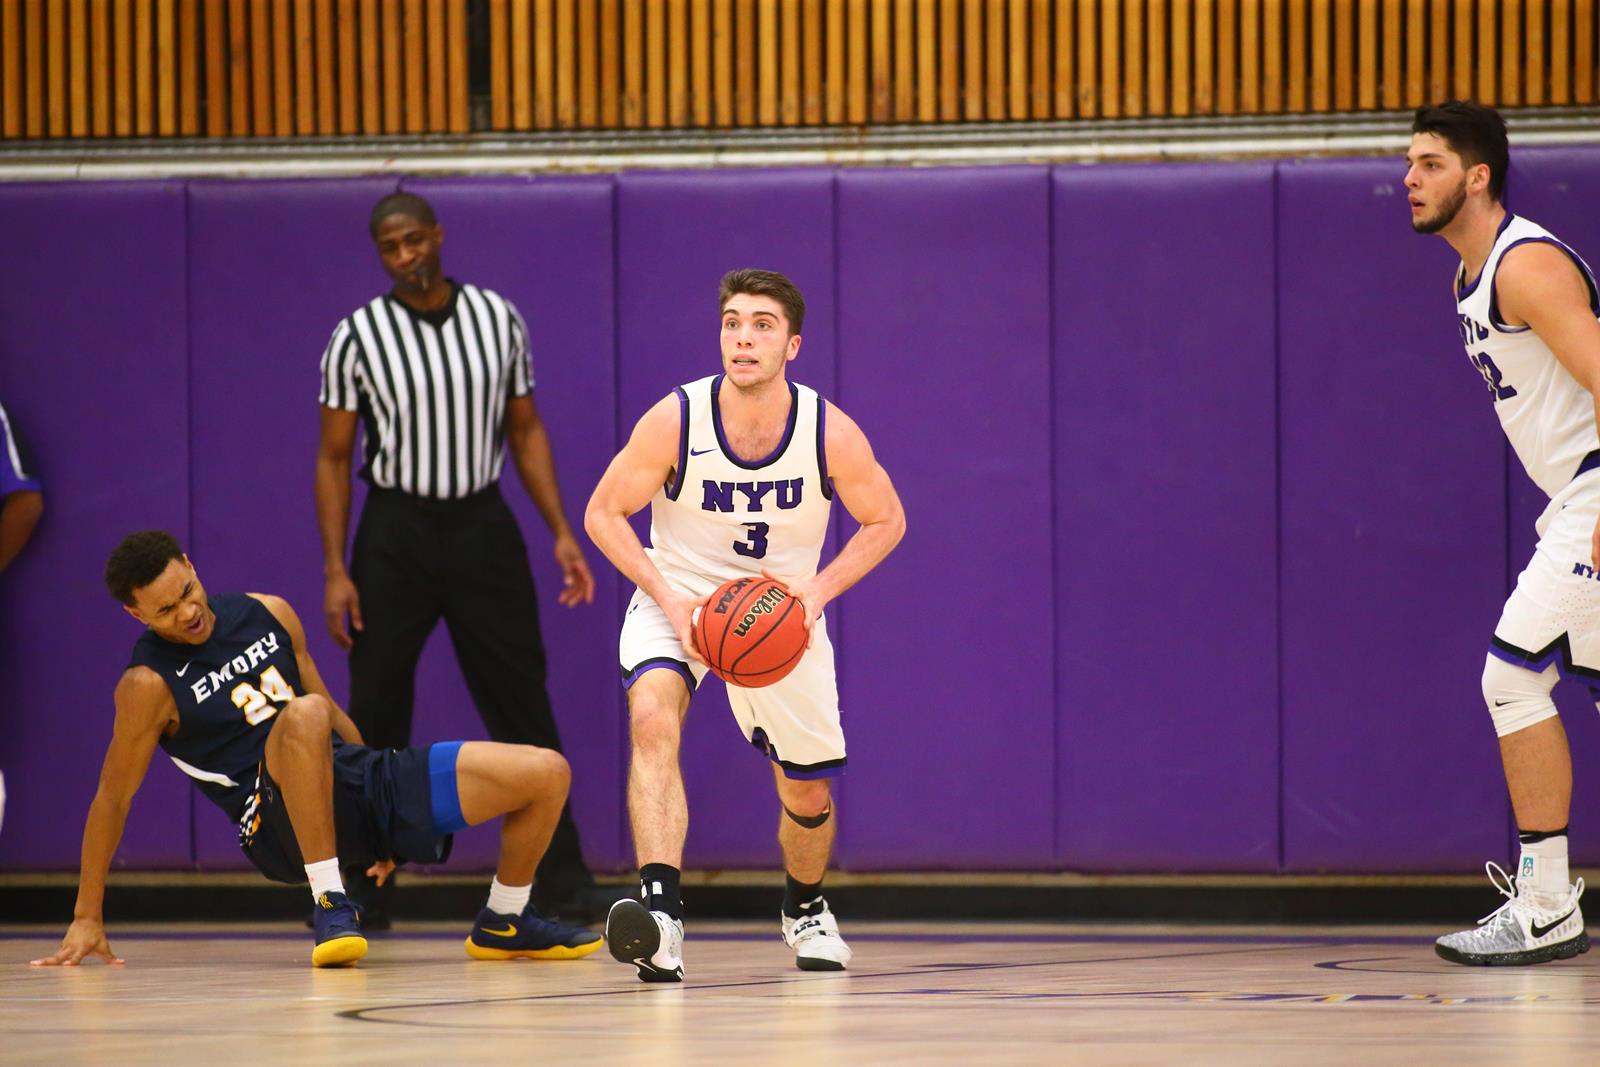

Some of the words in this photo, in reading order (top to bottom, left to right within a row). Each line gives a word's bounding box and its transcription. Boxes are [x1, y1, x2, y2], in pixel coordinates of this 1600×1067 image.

[1472, 351, 1518, 401] 2
[701, 477, 804, 513] NYU
[733, 521, 770, 560] 3
[1572, 562, 1600, 581] NY
[714, 578, 754, 615] NCAA
[733, 585, 786, 638] Wilson
[190, 632, 280, 704] EMORY
[231, 665, 297, 726] 24
